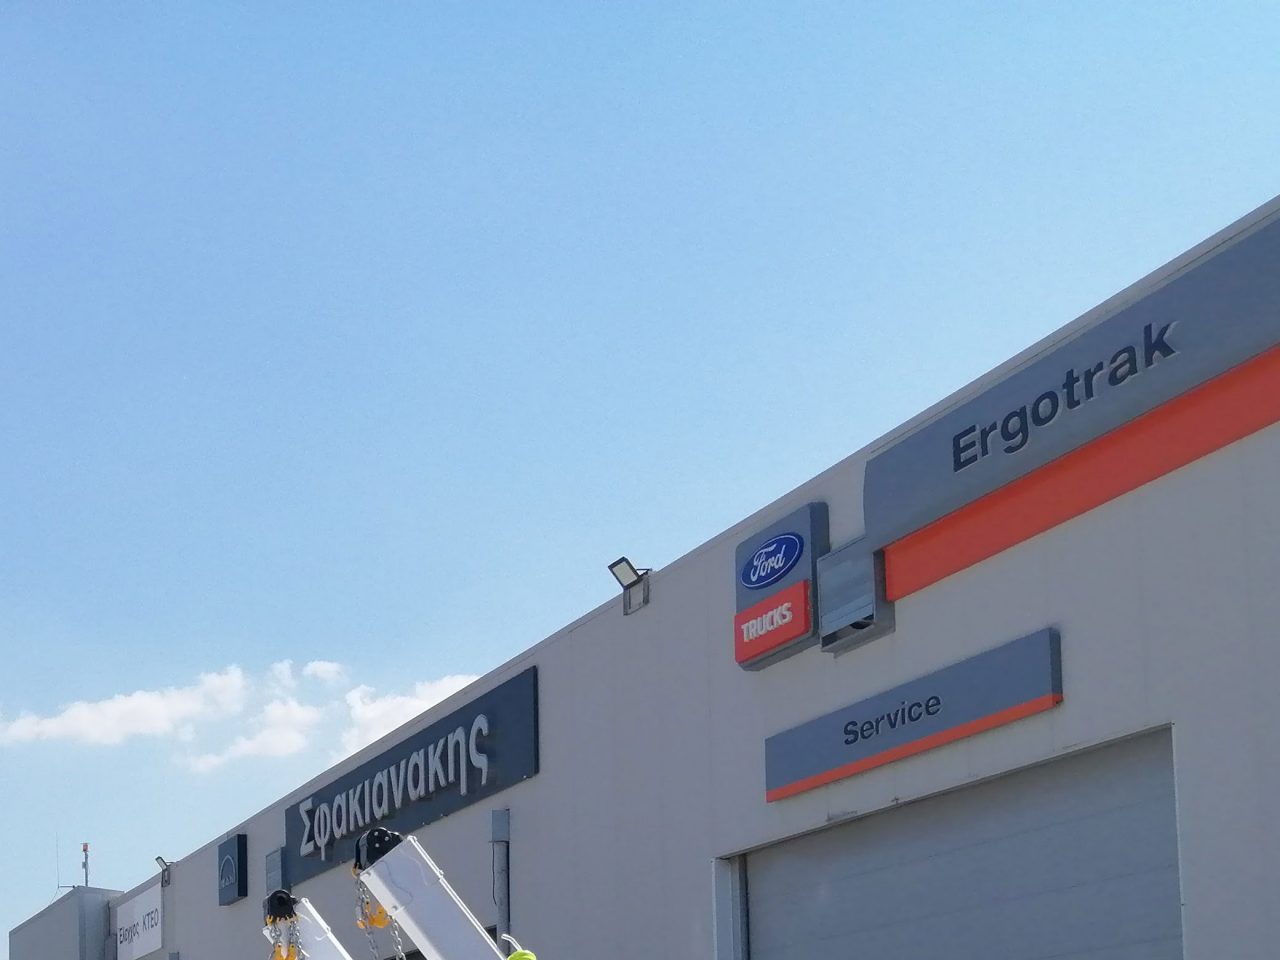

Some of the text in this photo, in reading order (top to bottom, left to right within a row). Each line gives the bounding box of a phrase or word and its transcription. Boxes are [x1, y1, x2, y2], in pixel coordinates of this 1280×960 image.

[952, 320, 1181, 473] Ergotrak
[750, 543, 787, 582] Ford
[741, 602, 794, 643] TRUCKS
[843, 695, 942, 745] Service
[299, 713, 489, 861] Σφακιανακης
